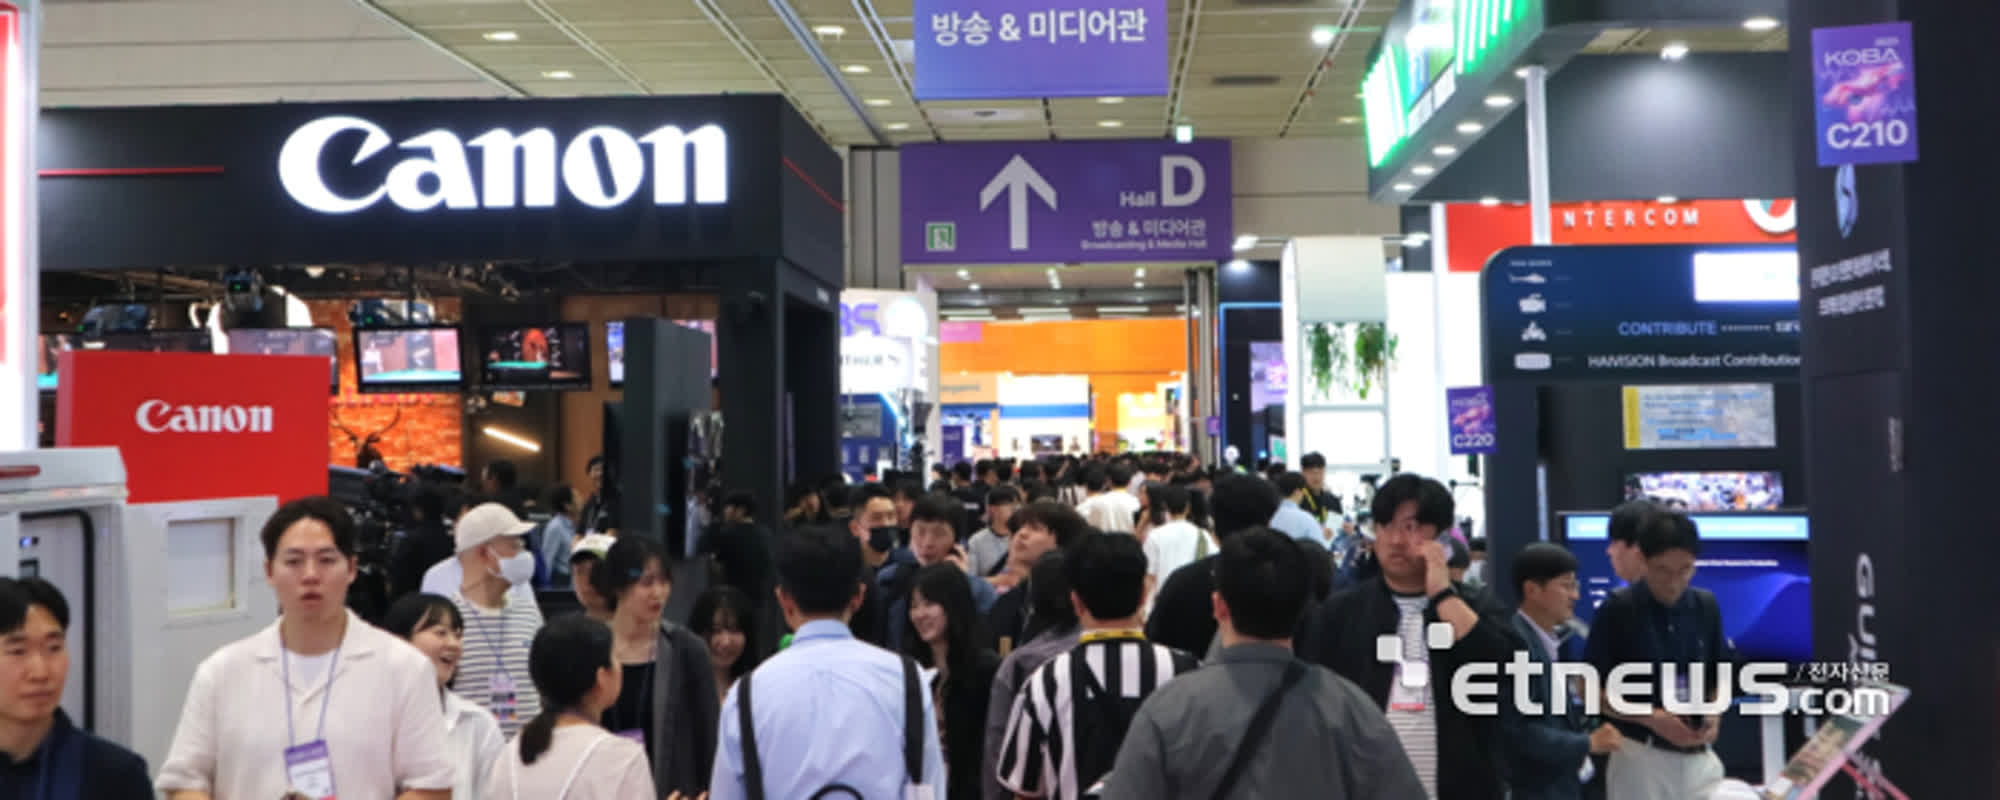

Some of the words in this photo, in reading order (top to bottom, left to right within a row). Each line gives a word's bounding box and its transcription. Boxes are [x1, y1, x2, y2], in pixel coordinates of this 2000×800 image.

[932, 11, 992, 46] 방송
[999, 13, 1021, 41] &
[1029, 8, 1148, 43] 미디어관
[1823, 47, 1901, 67] KOBA
[1826, 119, 1908, 149] C210
[278, 116, 728, 213] Canon
[1119, 191, 1156, 207] Hall
[1161, 155, 1206, 207] D
[1563, 207, 1699, 227] NTERCOM
[1092, 220, 1124, 239] 방송
[1128, 220, 1140, 236] &
[1143, 218, 1207, 238] 미디어관
[1618, 321, 1717, 336] CONTRIBUTE
[1658, 353, 1721, 368] Broadcast
[135, 399, 273, 433] Canon
[1454, 432, 1495, 449] C220
